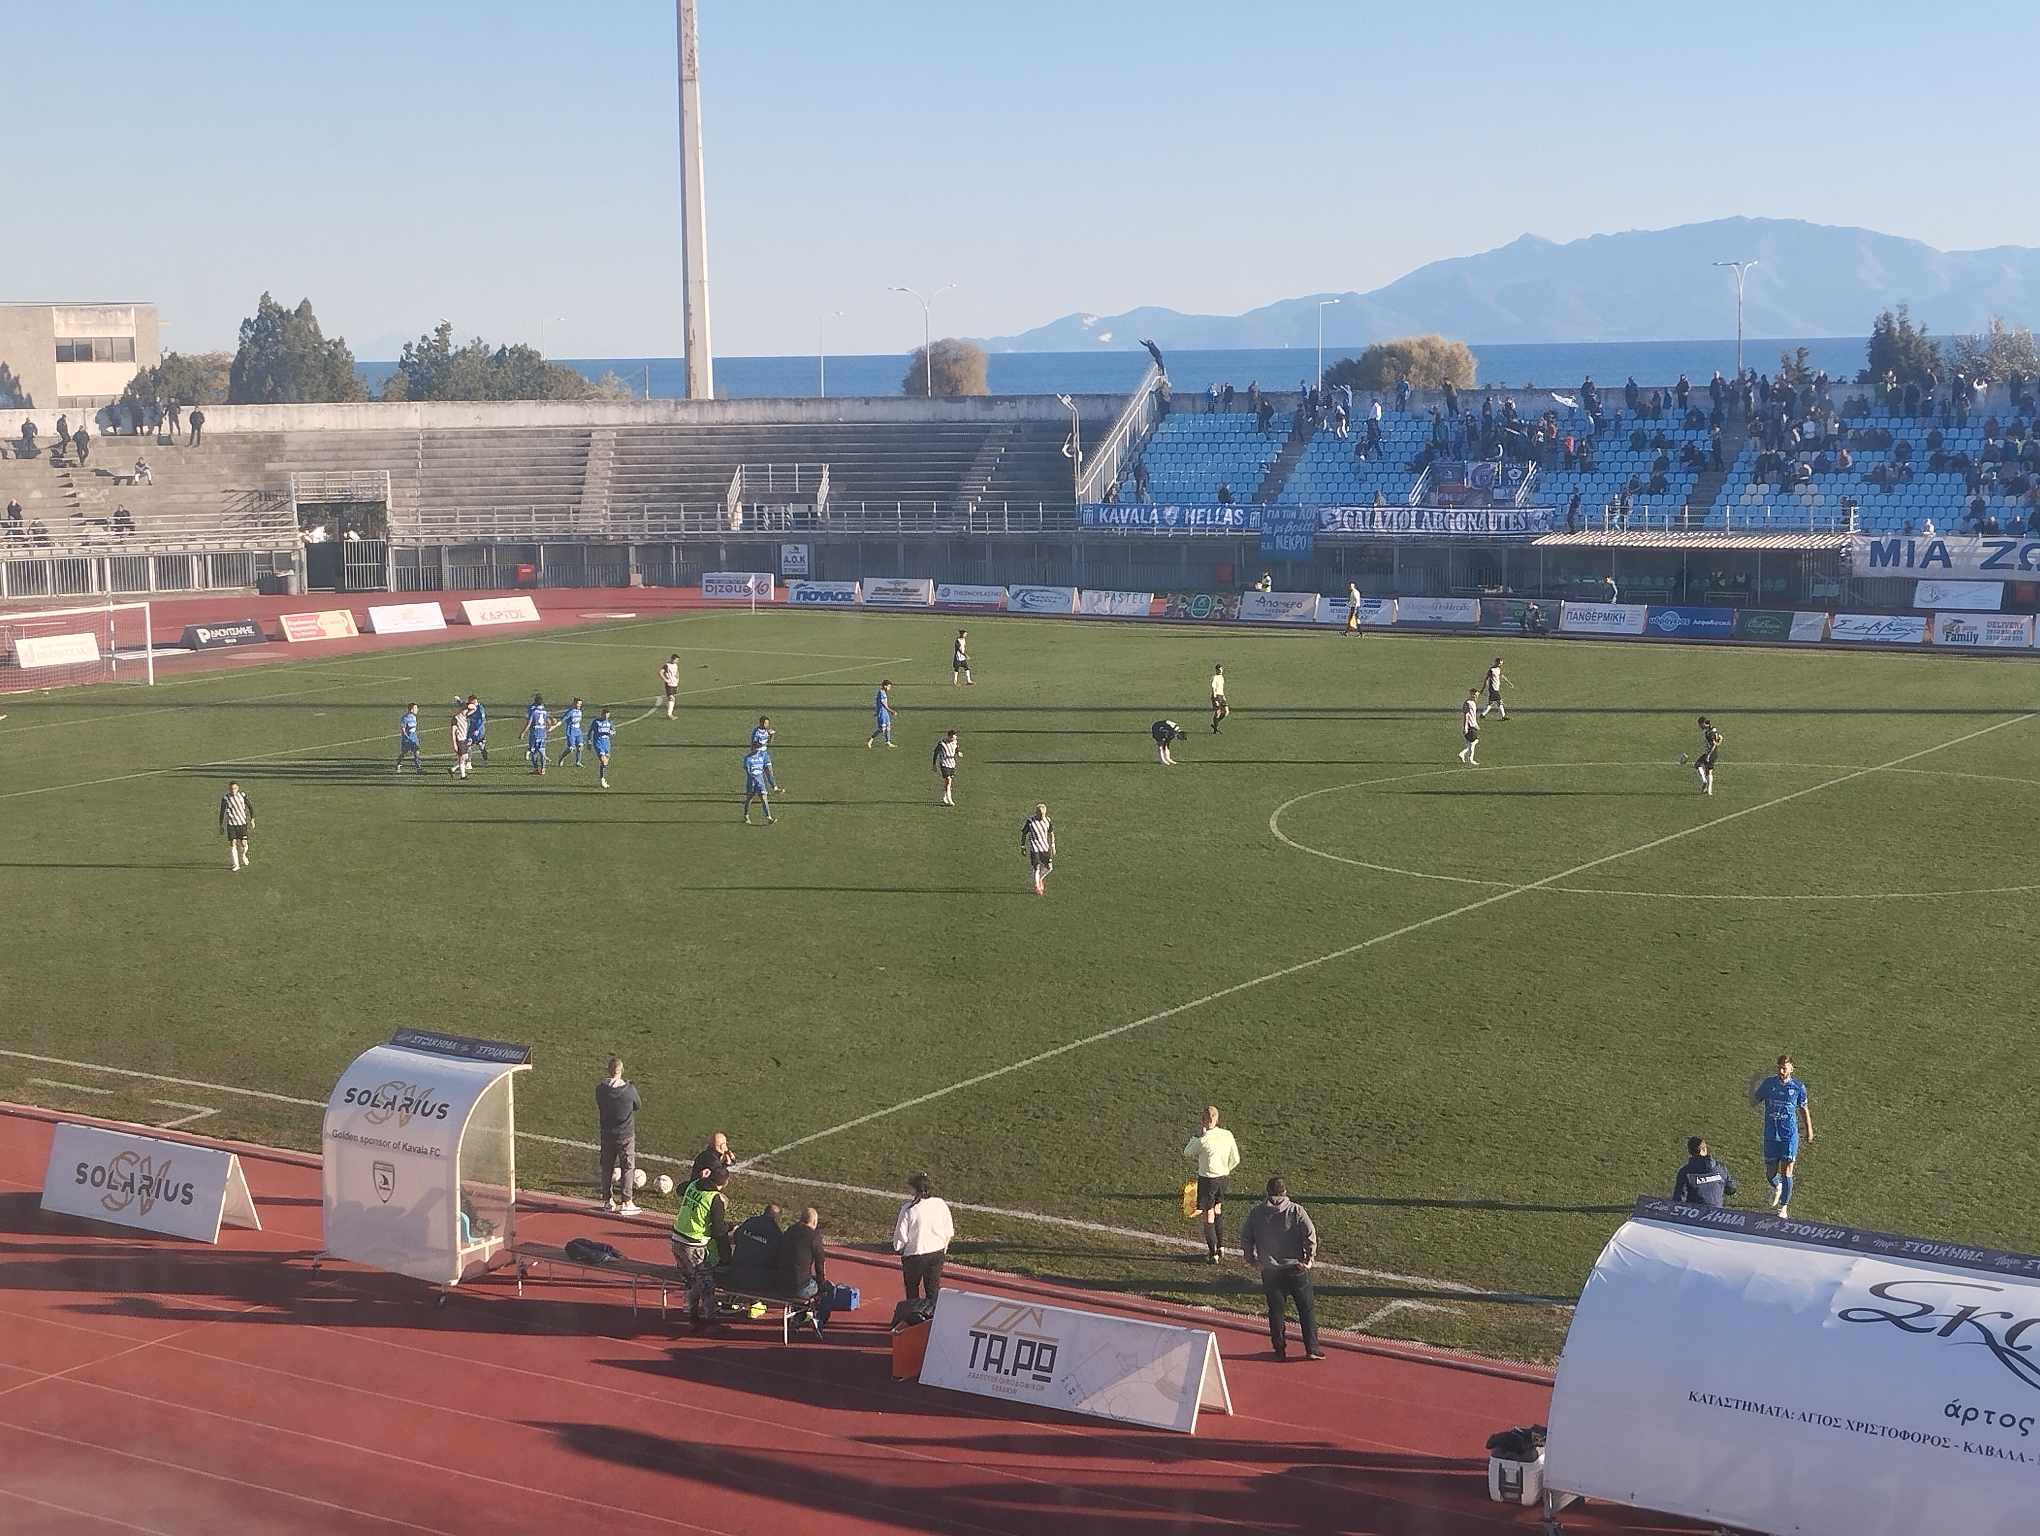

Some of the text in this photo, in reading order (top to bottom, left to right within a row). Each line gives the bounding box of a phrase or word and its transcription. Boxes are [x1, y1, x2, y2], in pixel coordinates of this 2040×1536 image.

[1099, 507, 1244, 525] KAVALA HELLAS
[1421, 511, 1526, 531] ARGONAUTES
[1870, 539, 1952, 568] ΜΙΑ
[1104, 592, 1145, 604] PASTEL
[1945, 632, 1979, 644] Family
[344, 1087, 450, 1120] SOLARIUS
[332, 1129, 441, 1157] Golden sponsor of Kavala FC
[75, 1162, 195, 1205] SOLARIUS
[1688, 1391, 1795, 1419] ΚΑΤΑΣΤΗΜΑΤΑ:
[1797, 1411, 1842, 1429] ΑΓΙΟΣ
[1846, 1419, 1951, 1448] ΧΡΙΣΤΟΦΟΡΟΣ
[1963, 1441, 2025, 1463] ΚΑΒΑΛΑ
[1944, 1398, 2035, 1437] άρτος
